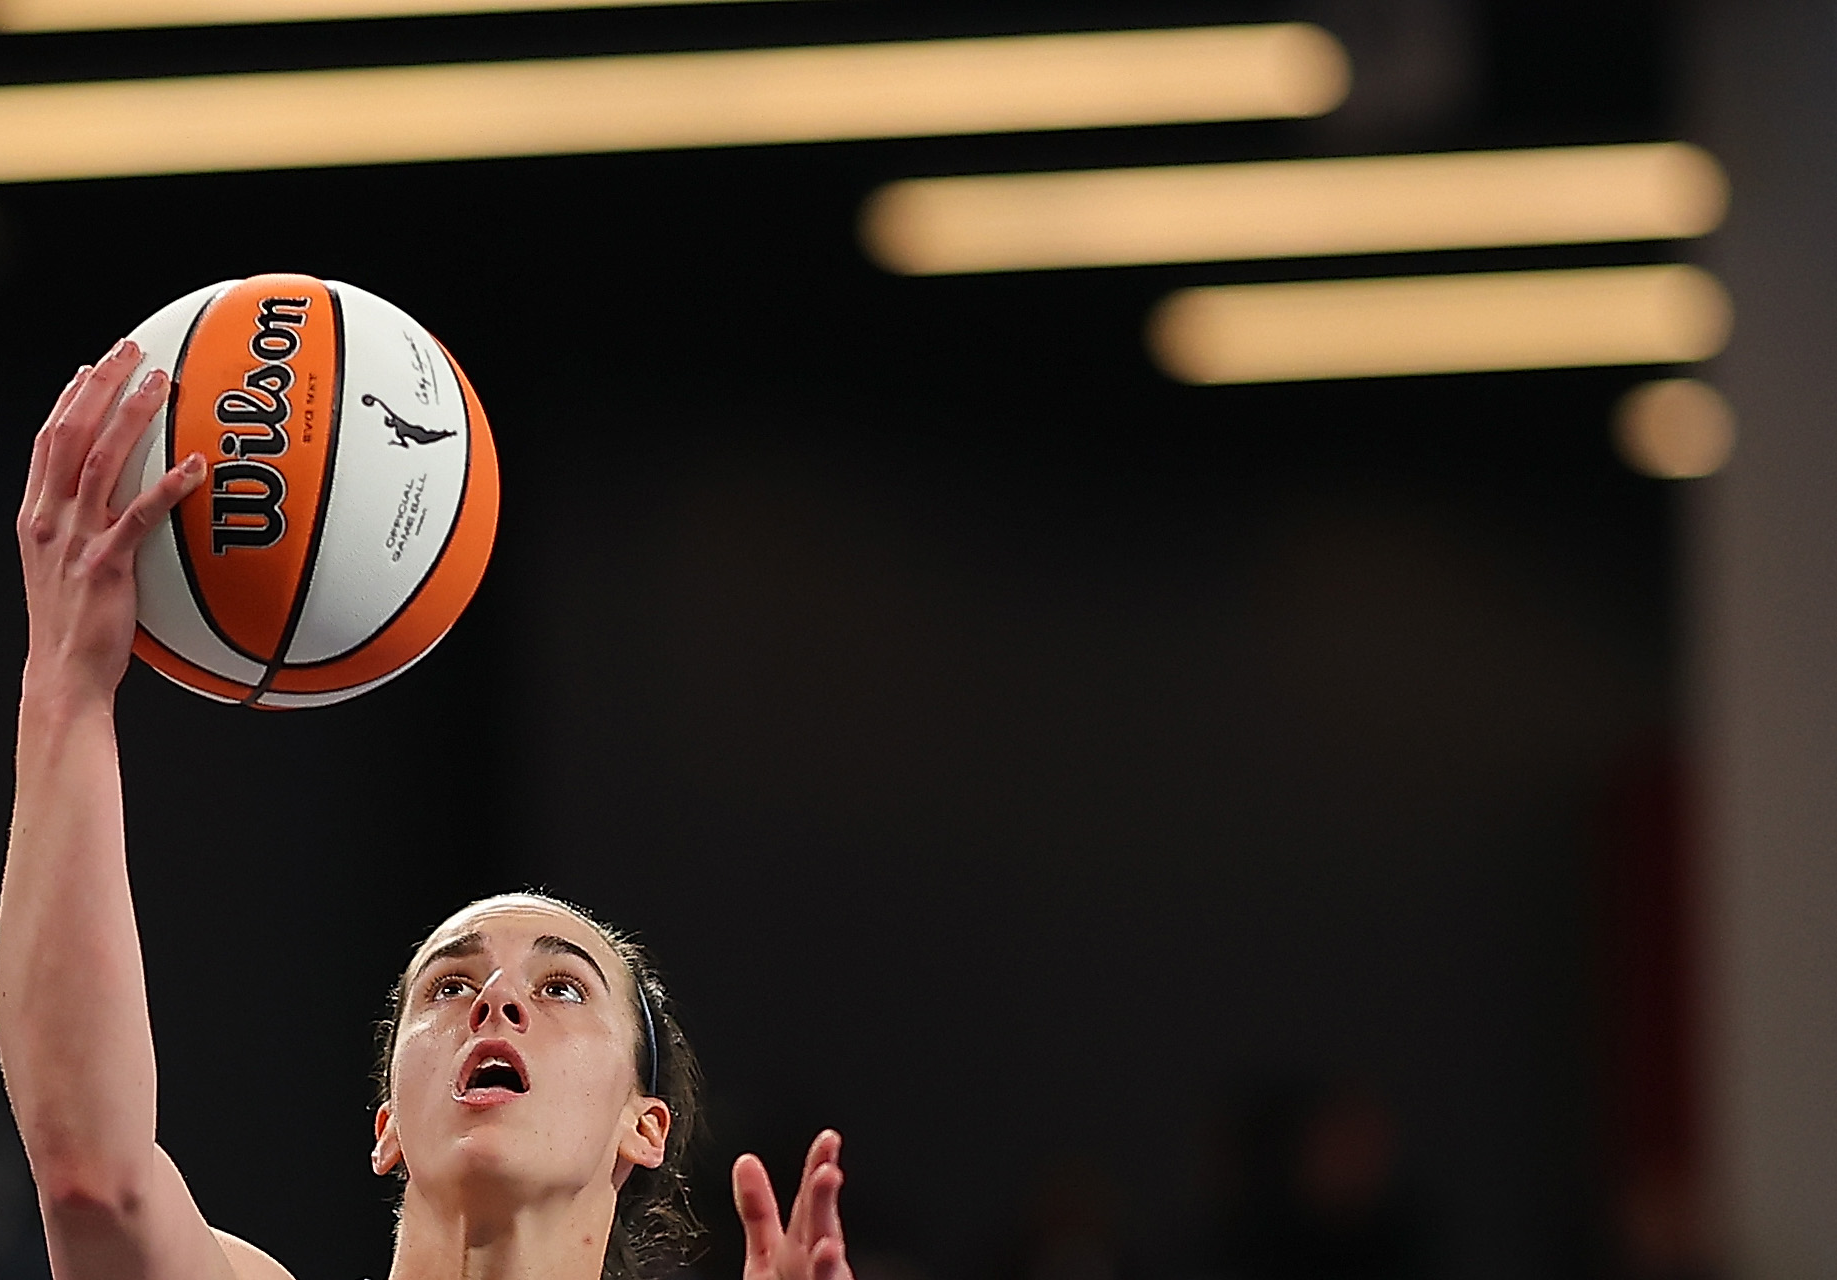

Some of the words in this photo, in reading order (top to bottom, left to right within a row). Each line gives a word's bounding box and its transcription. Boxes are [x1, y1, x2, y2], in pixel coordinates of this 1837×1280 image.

[211, 295, 312, 556] Wilson
[385, 478, 414, 549] OFFICIAL
[392, 516, 415, 562] GAME
[410, 473, 427, 514] BALL
